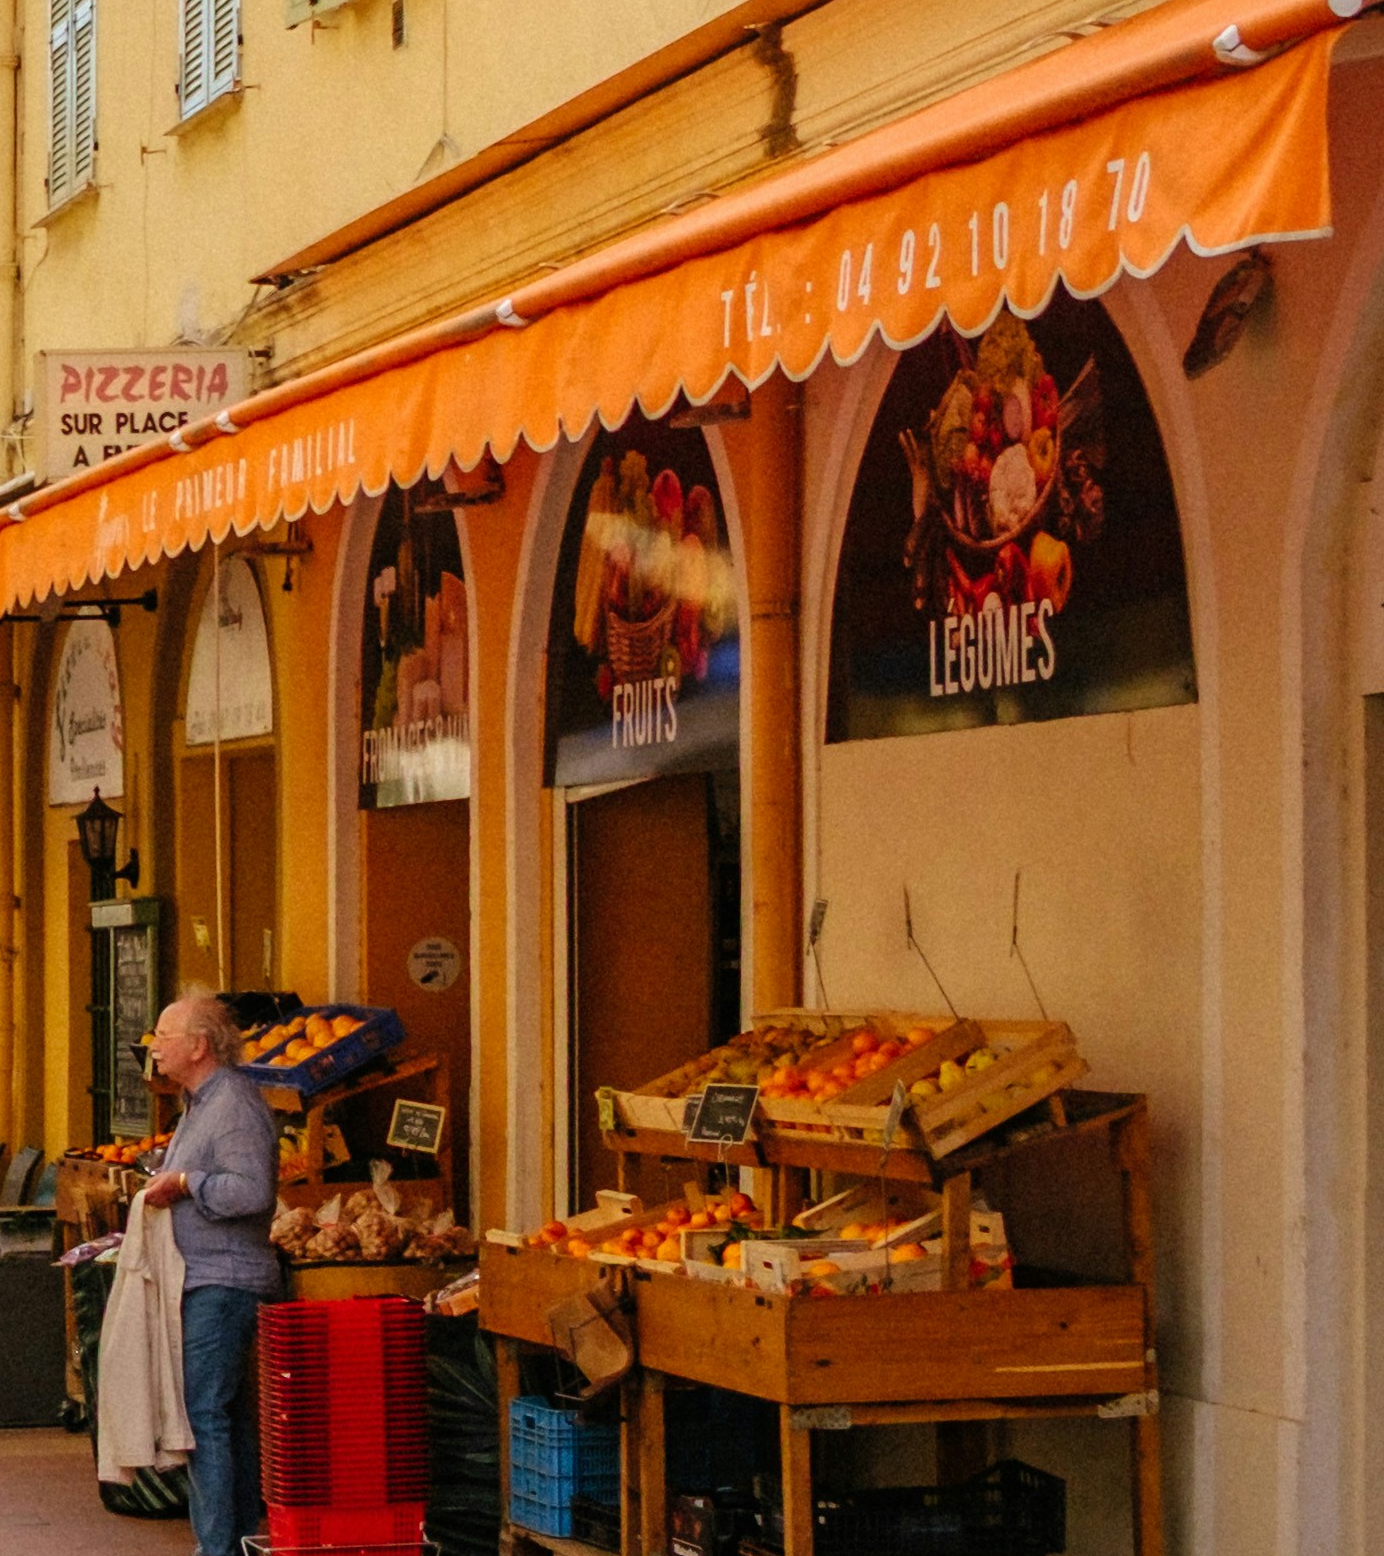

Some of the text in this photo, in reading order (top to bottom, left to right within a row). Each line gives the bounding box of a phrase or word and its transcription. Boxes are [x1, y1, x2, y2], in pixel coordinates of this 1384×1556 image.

[837, 249, 874, 312] 04
[897, 222, 941, 295] 92
[969, 201, 1009, 276] 10
[1038, 179, 1077, 256] 18
[1106, 150, 1150, 231] 70
[60, 362, 228, 404] PIZZERIA
[61, 412, 102, 435] SUR
[73, 445, 90, 467] A
[268, 418, 356, 492] FAMILIAL
[929, 597, 1054, 697] LÉGUMES
[612, 676, 677, 748] FRUITS
